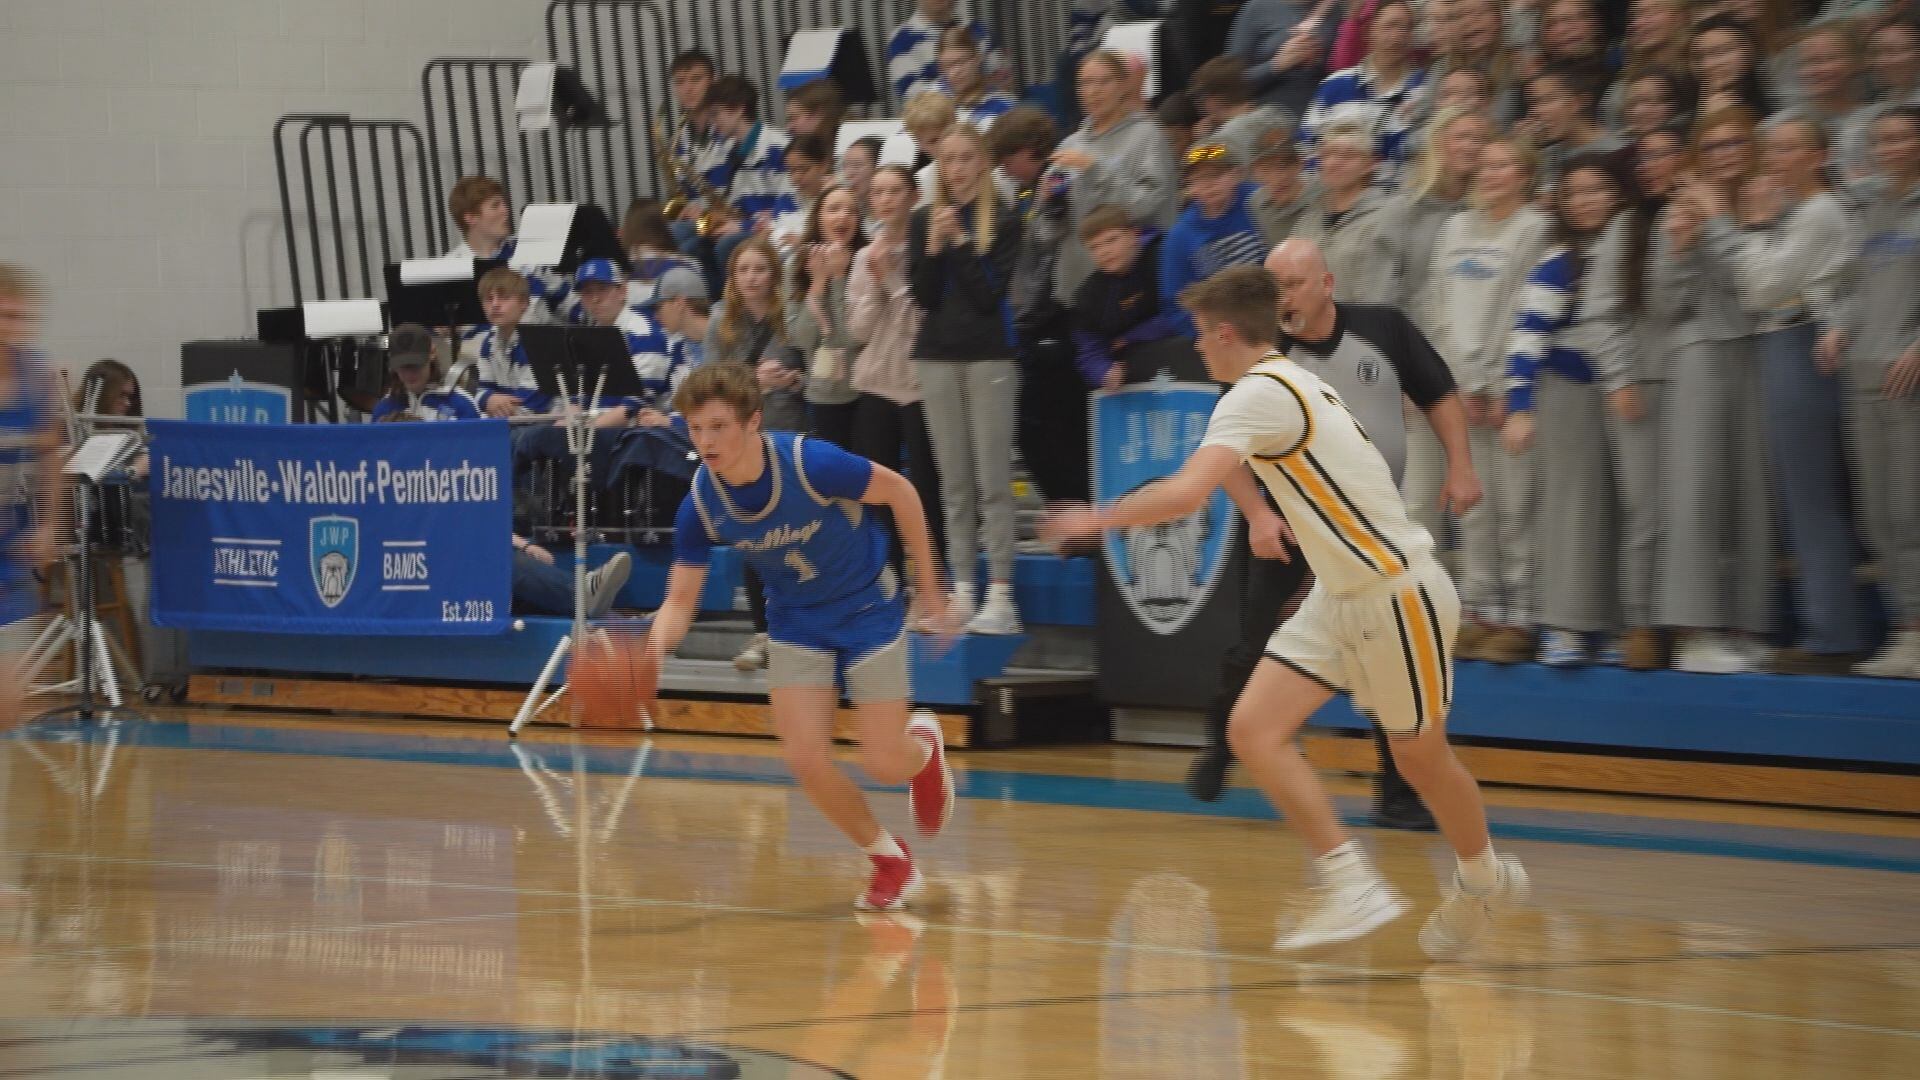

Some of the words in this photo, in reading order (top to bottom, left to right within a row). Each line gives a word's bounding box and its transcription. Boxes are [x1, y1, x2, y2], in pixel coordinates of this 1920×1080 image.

[213, 547, 279, 578] ATHLETIC
[383, 552, 428, 581] BANDS
[783, 549, 821, 583] 1
